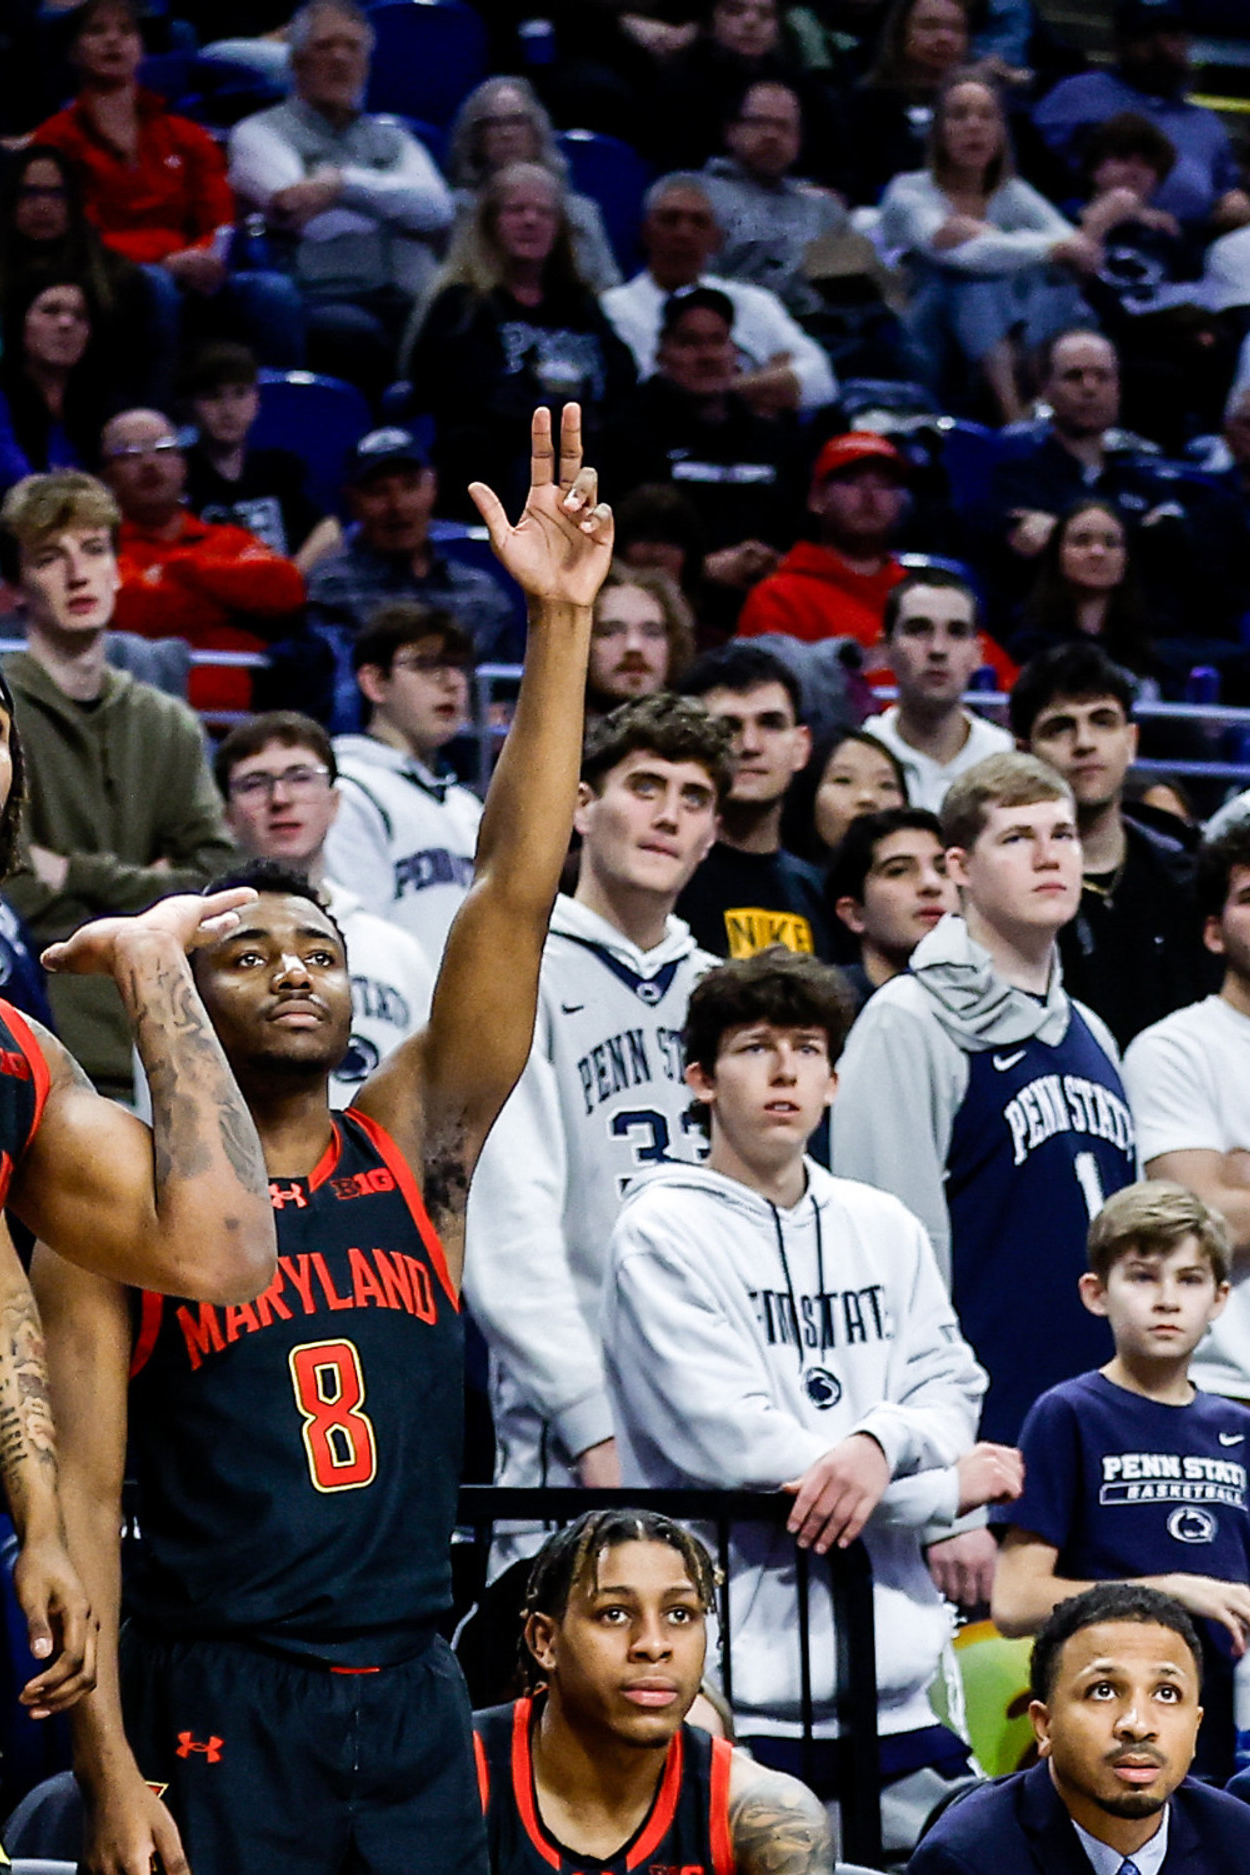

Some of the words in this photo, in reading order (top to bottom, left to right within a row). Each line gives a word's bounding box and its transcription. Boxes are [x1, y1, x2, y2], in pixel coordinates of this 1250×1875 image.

[578, 1028, 652, 1115] PENN
[1004, 1073, 1072, 1166] PENN
[175, 1248, 438, 1371] MARYLAND
[288, 1337, 377, 1493] 8
[1102, 1454, 1181, 1481] PENN
[1127, 1484, 1243, 1505] BASKETBALL
